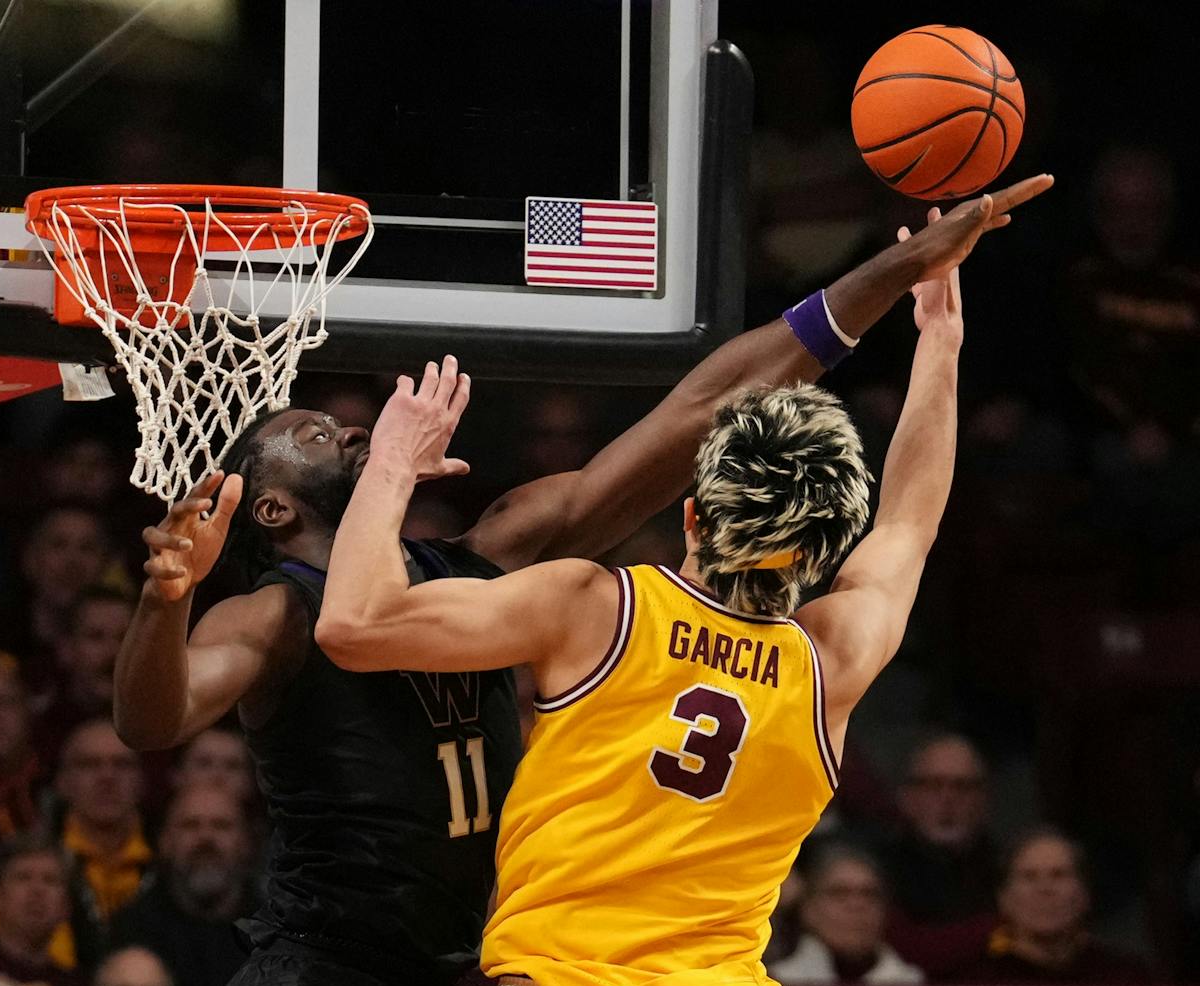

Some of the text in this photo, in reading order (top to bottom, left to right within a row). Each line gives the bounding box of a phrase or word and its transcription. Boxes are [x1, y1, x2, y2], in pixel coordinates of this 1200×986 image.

[668, 619, 780, 689] GARCIA
[437, 736, 493, 839] 11
[647, 682, 751, 803] 3
